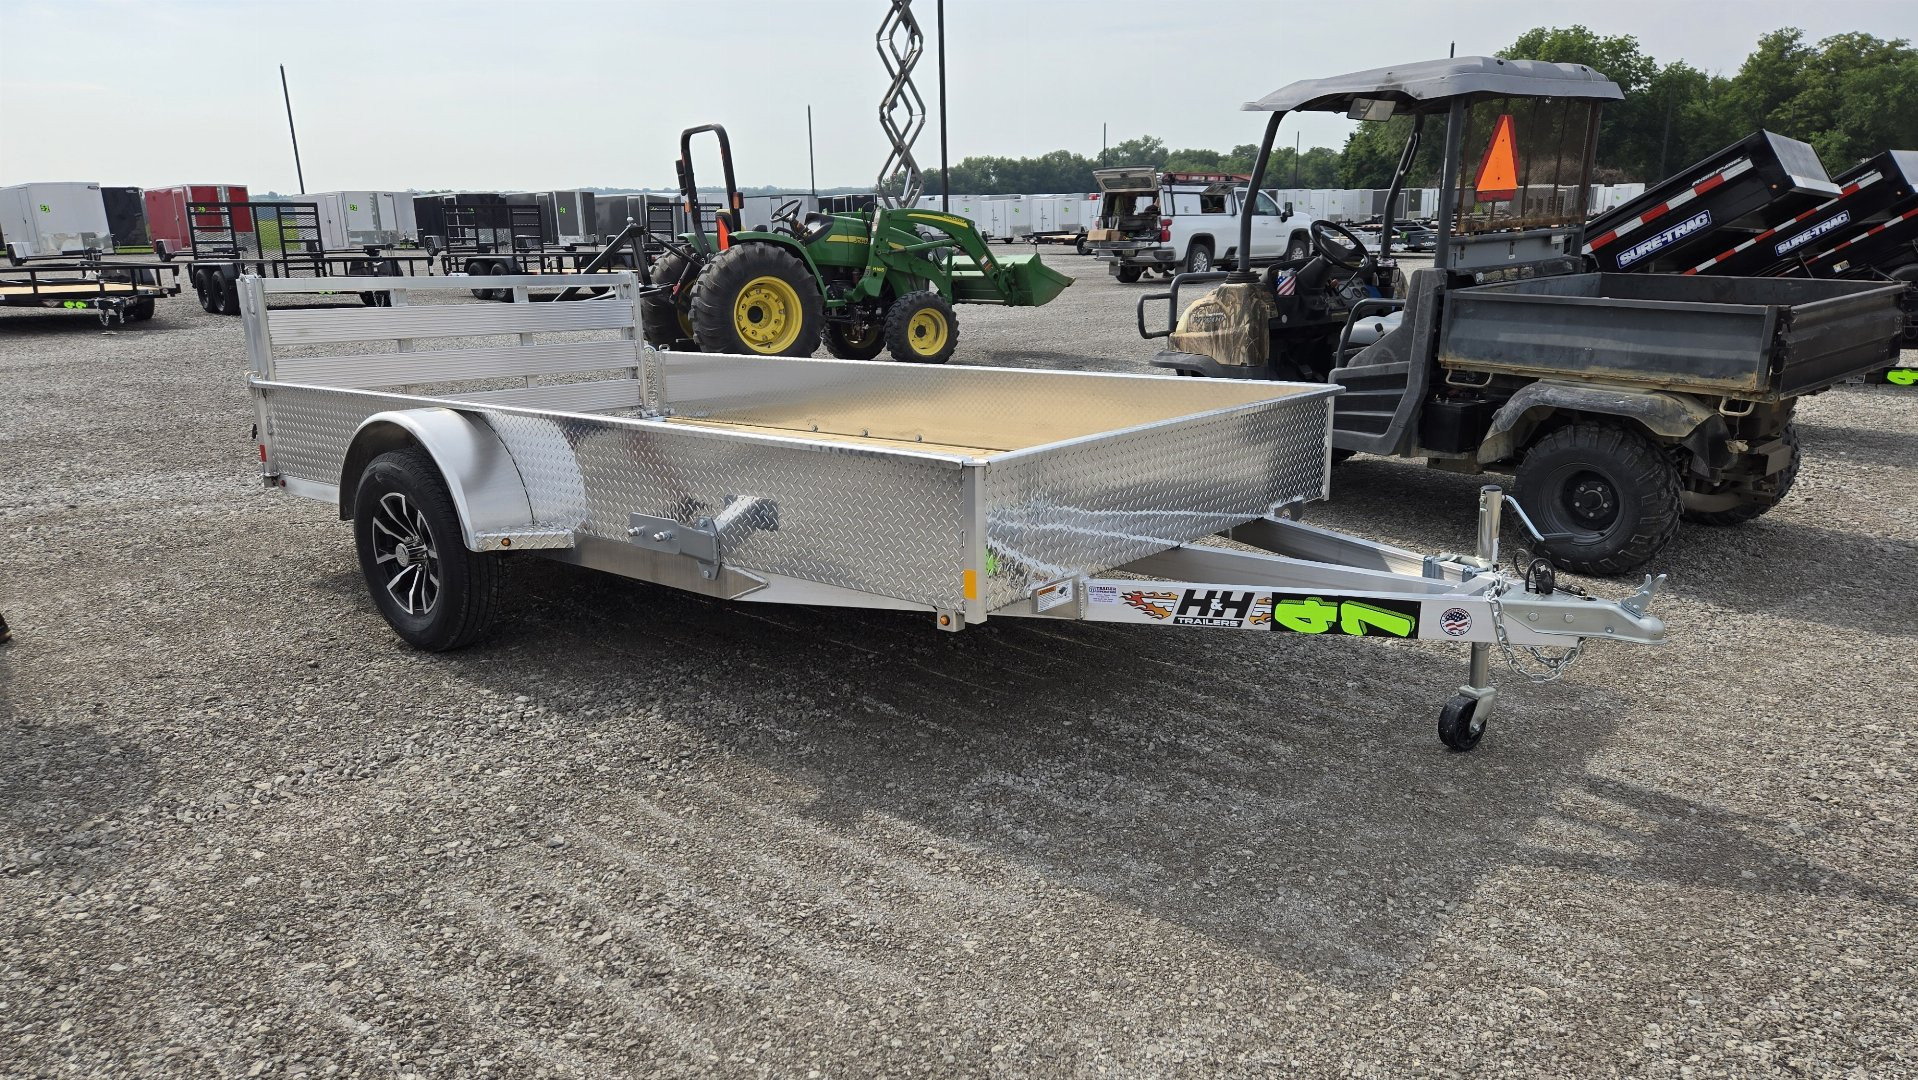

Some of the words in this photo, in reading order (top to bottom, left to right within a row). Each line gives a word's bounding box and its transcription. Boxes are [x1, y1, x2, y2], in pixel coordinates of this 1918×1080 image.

[1620, 214, 1708, 265] SURE-TRAC
[1778, 213, 1848, 254] SURE-TRAC
[1176, 589, 1255, 619] H&H
[1177, 617, 1239, 627] TRAILERS
